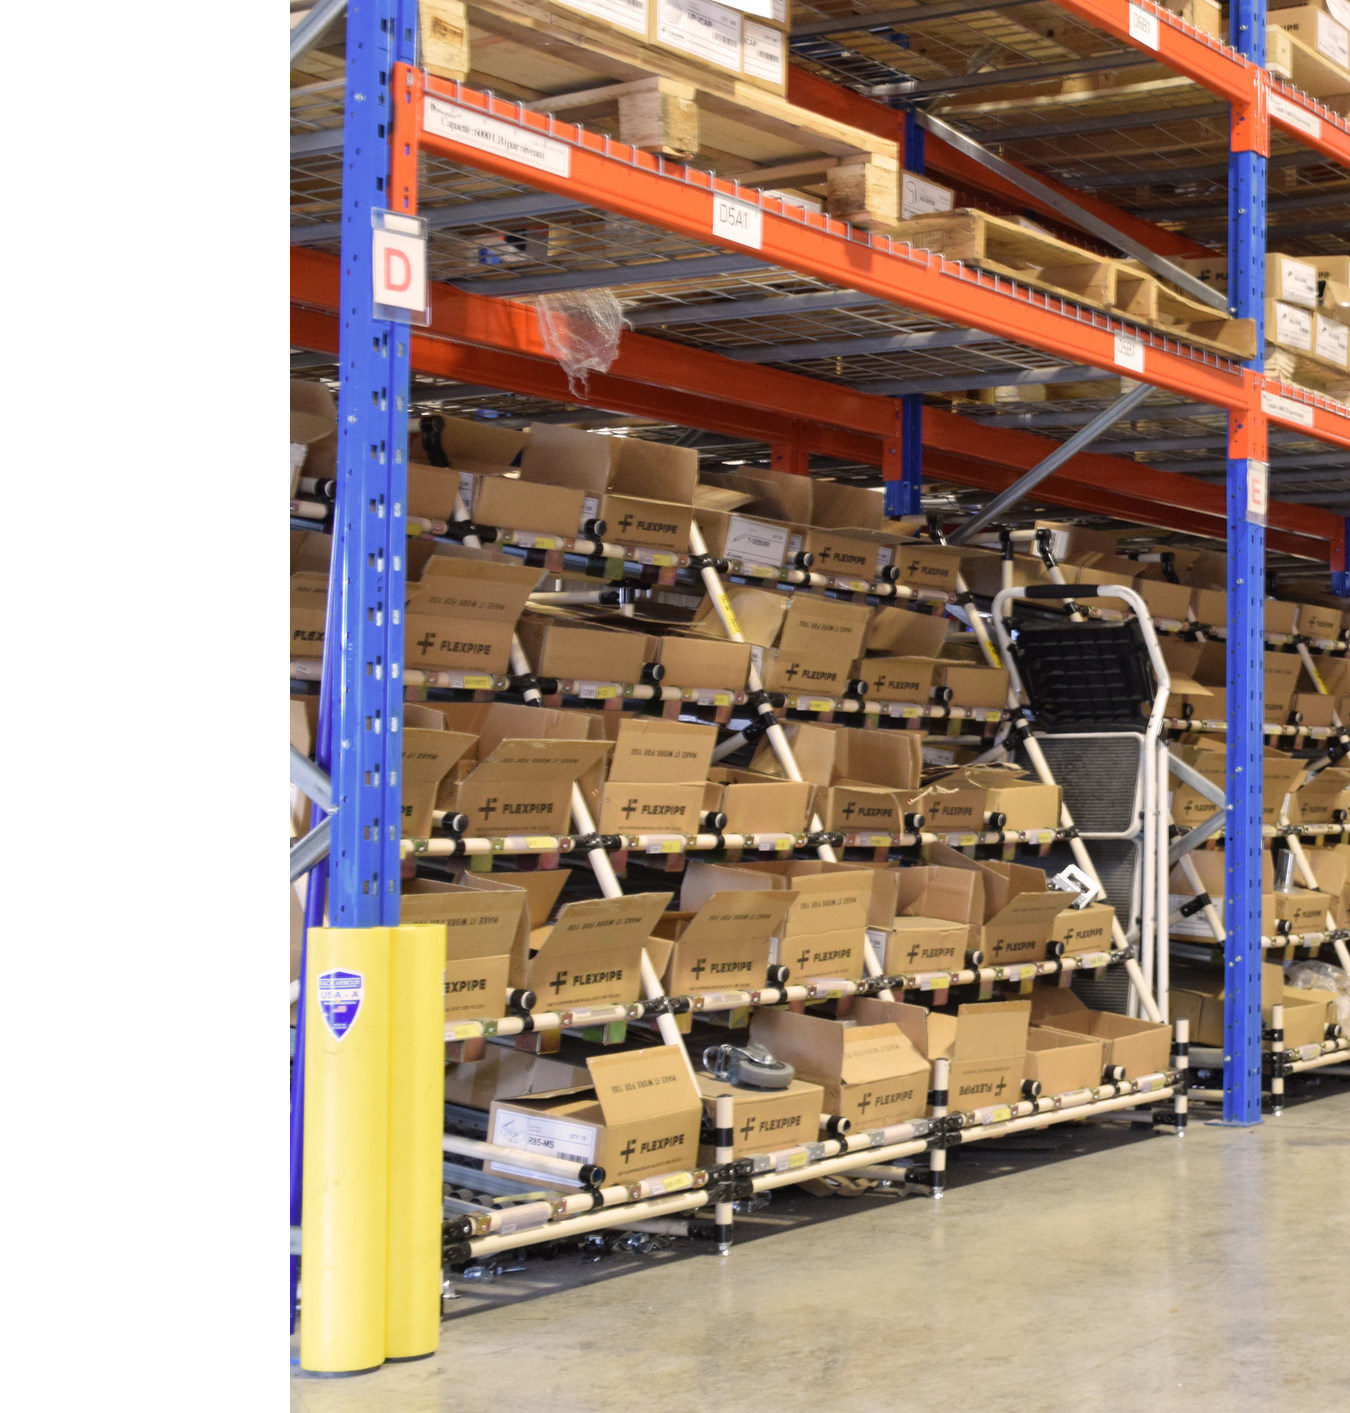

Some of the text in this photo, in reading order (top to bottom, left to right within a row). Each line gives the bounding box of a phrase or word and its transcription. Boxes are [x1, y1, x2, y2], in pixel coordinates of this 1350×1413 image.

[719, 203, 749, 231] D5A1
[383, 248, 412, 293] D
[1251, 478, 1262, 505] E
[636, 521, 678, 535] FLEXPIPE
[293, 629, 325, 642] FLEX
[440, 640, 492, 655] FLEXPIPE
[802, 669, 837, 682] FLEXPIPE
[887, 679, 920, 691] FLEXPIPE
[502, 802, 553, 815] FLEXPIPE
[641, 803, 686, 816] FLEXPIPE
[858, 807, 893, 818] FLEXPIPE
[942, 806, 973, 817] FLEXPIPE
[813, 947, 852, 963] FLEXPIPE
[921, 946, 955, 959] FLEXPIPE
[710, 960, 753, 975] FLEXPIPE
[573, 969, 623, 987] FLEXPIPE
[445, 978, 487, 994] EXPIPE
[320, 991, 341, 1000] USA
[959, 1082, 992, 1097] FLEXPIPE
[874, 1089, 914, 1106] FLEXPIPE
[758, 1115, 802, 1133] FLEXPIPE
[639, 1133, 685, 1154] FLEXPIPE
